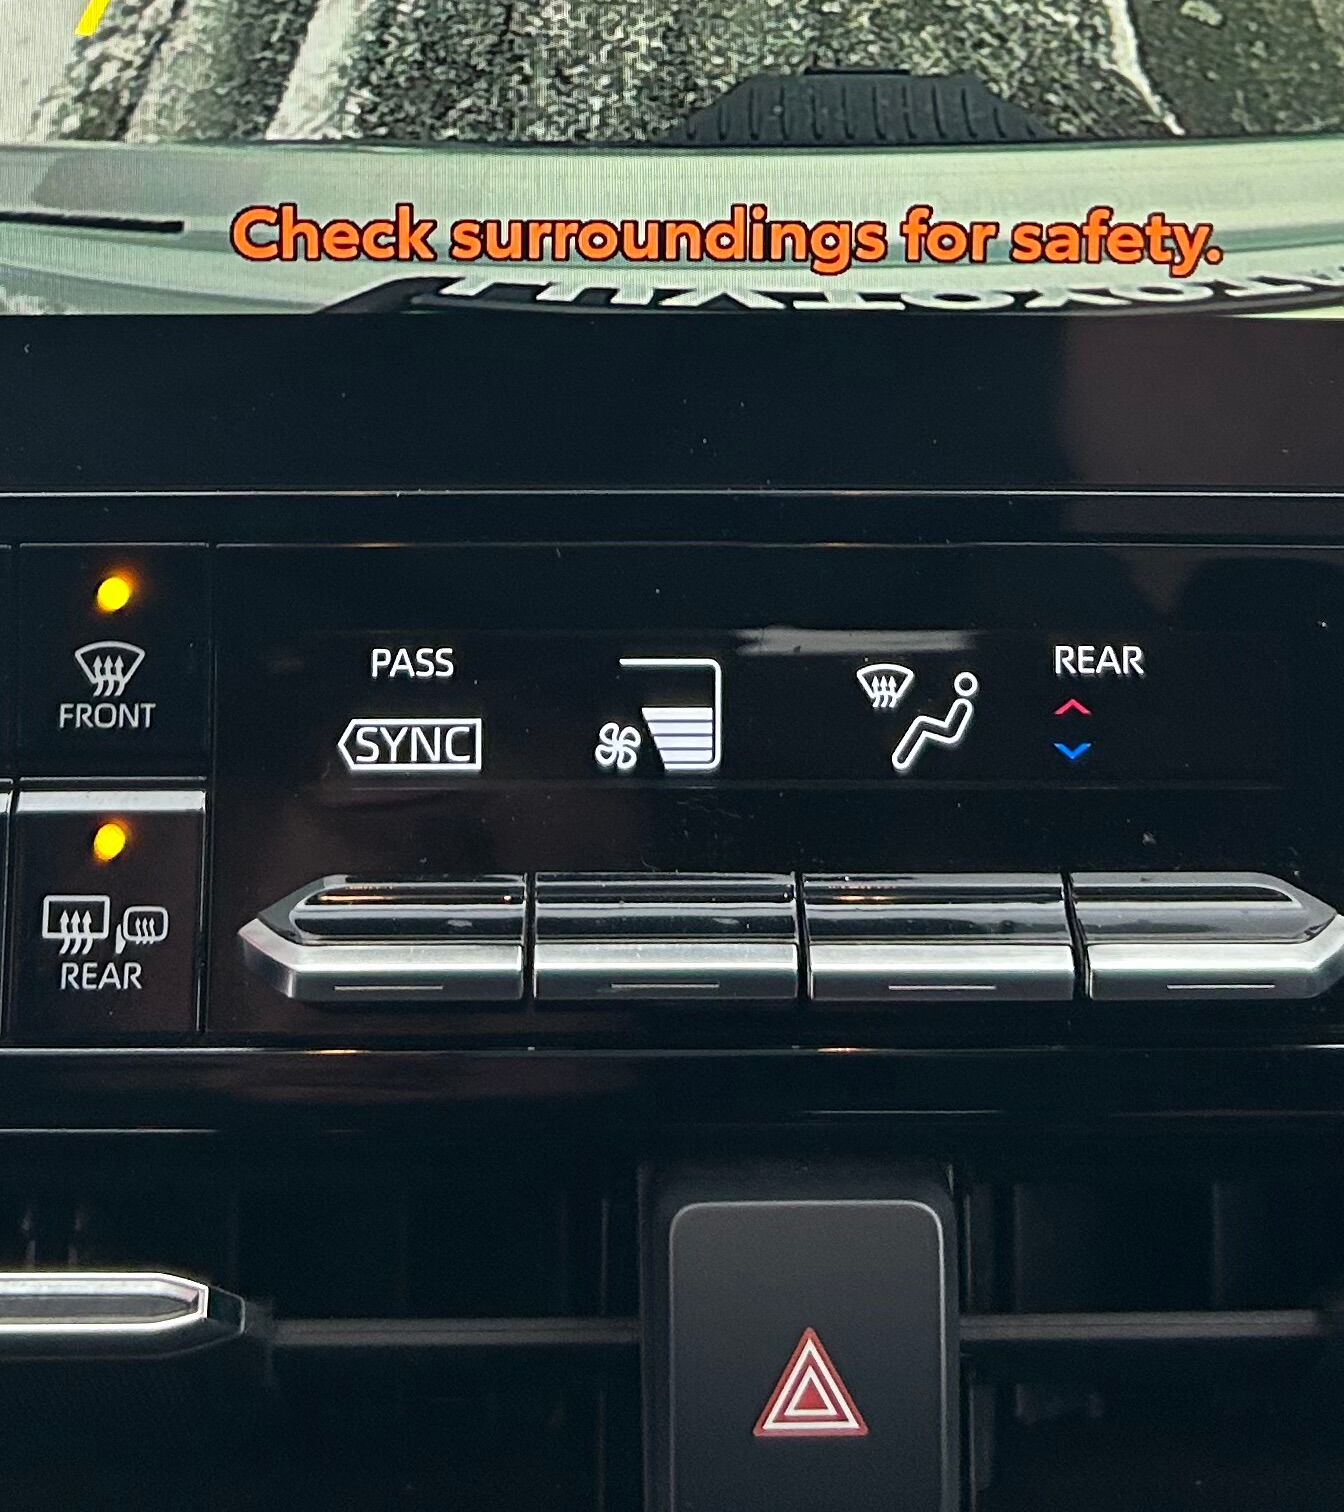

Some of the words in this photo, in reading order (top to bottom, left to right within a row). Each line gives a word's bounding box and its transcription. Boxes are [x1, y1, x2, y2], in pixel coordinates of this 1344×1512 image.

[230, 205, 434, 261] Check
[451, 205, 888, 276] surroundings
[900, 206, 999, 263] for
[1010, 207, 1224, 278] safety.
[370, 646, 455, 679] PASS
[1054, 644, 1146, 677] REAR
[58, 701, 157, 730] FRONT
[355, 725, 471, 765] SYNC
[59, 960, 143, 991] REAR
